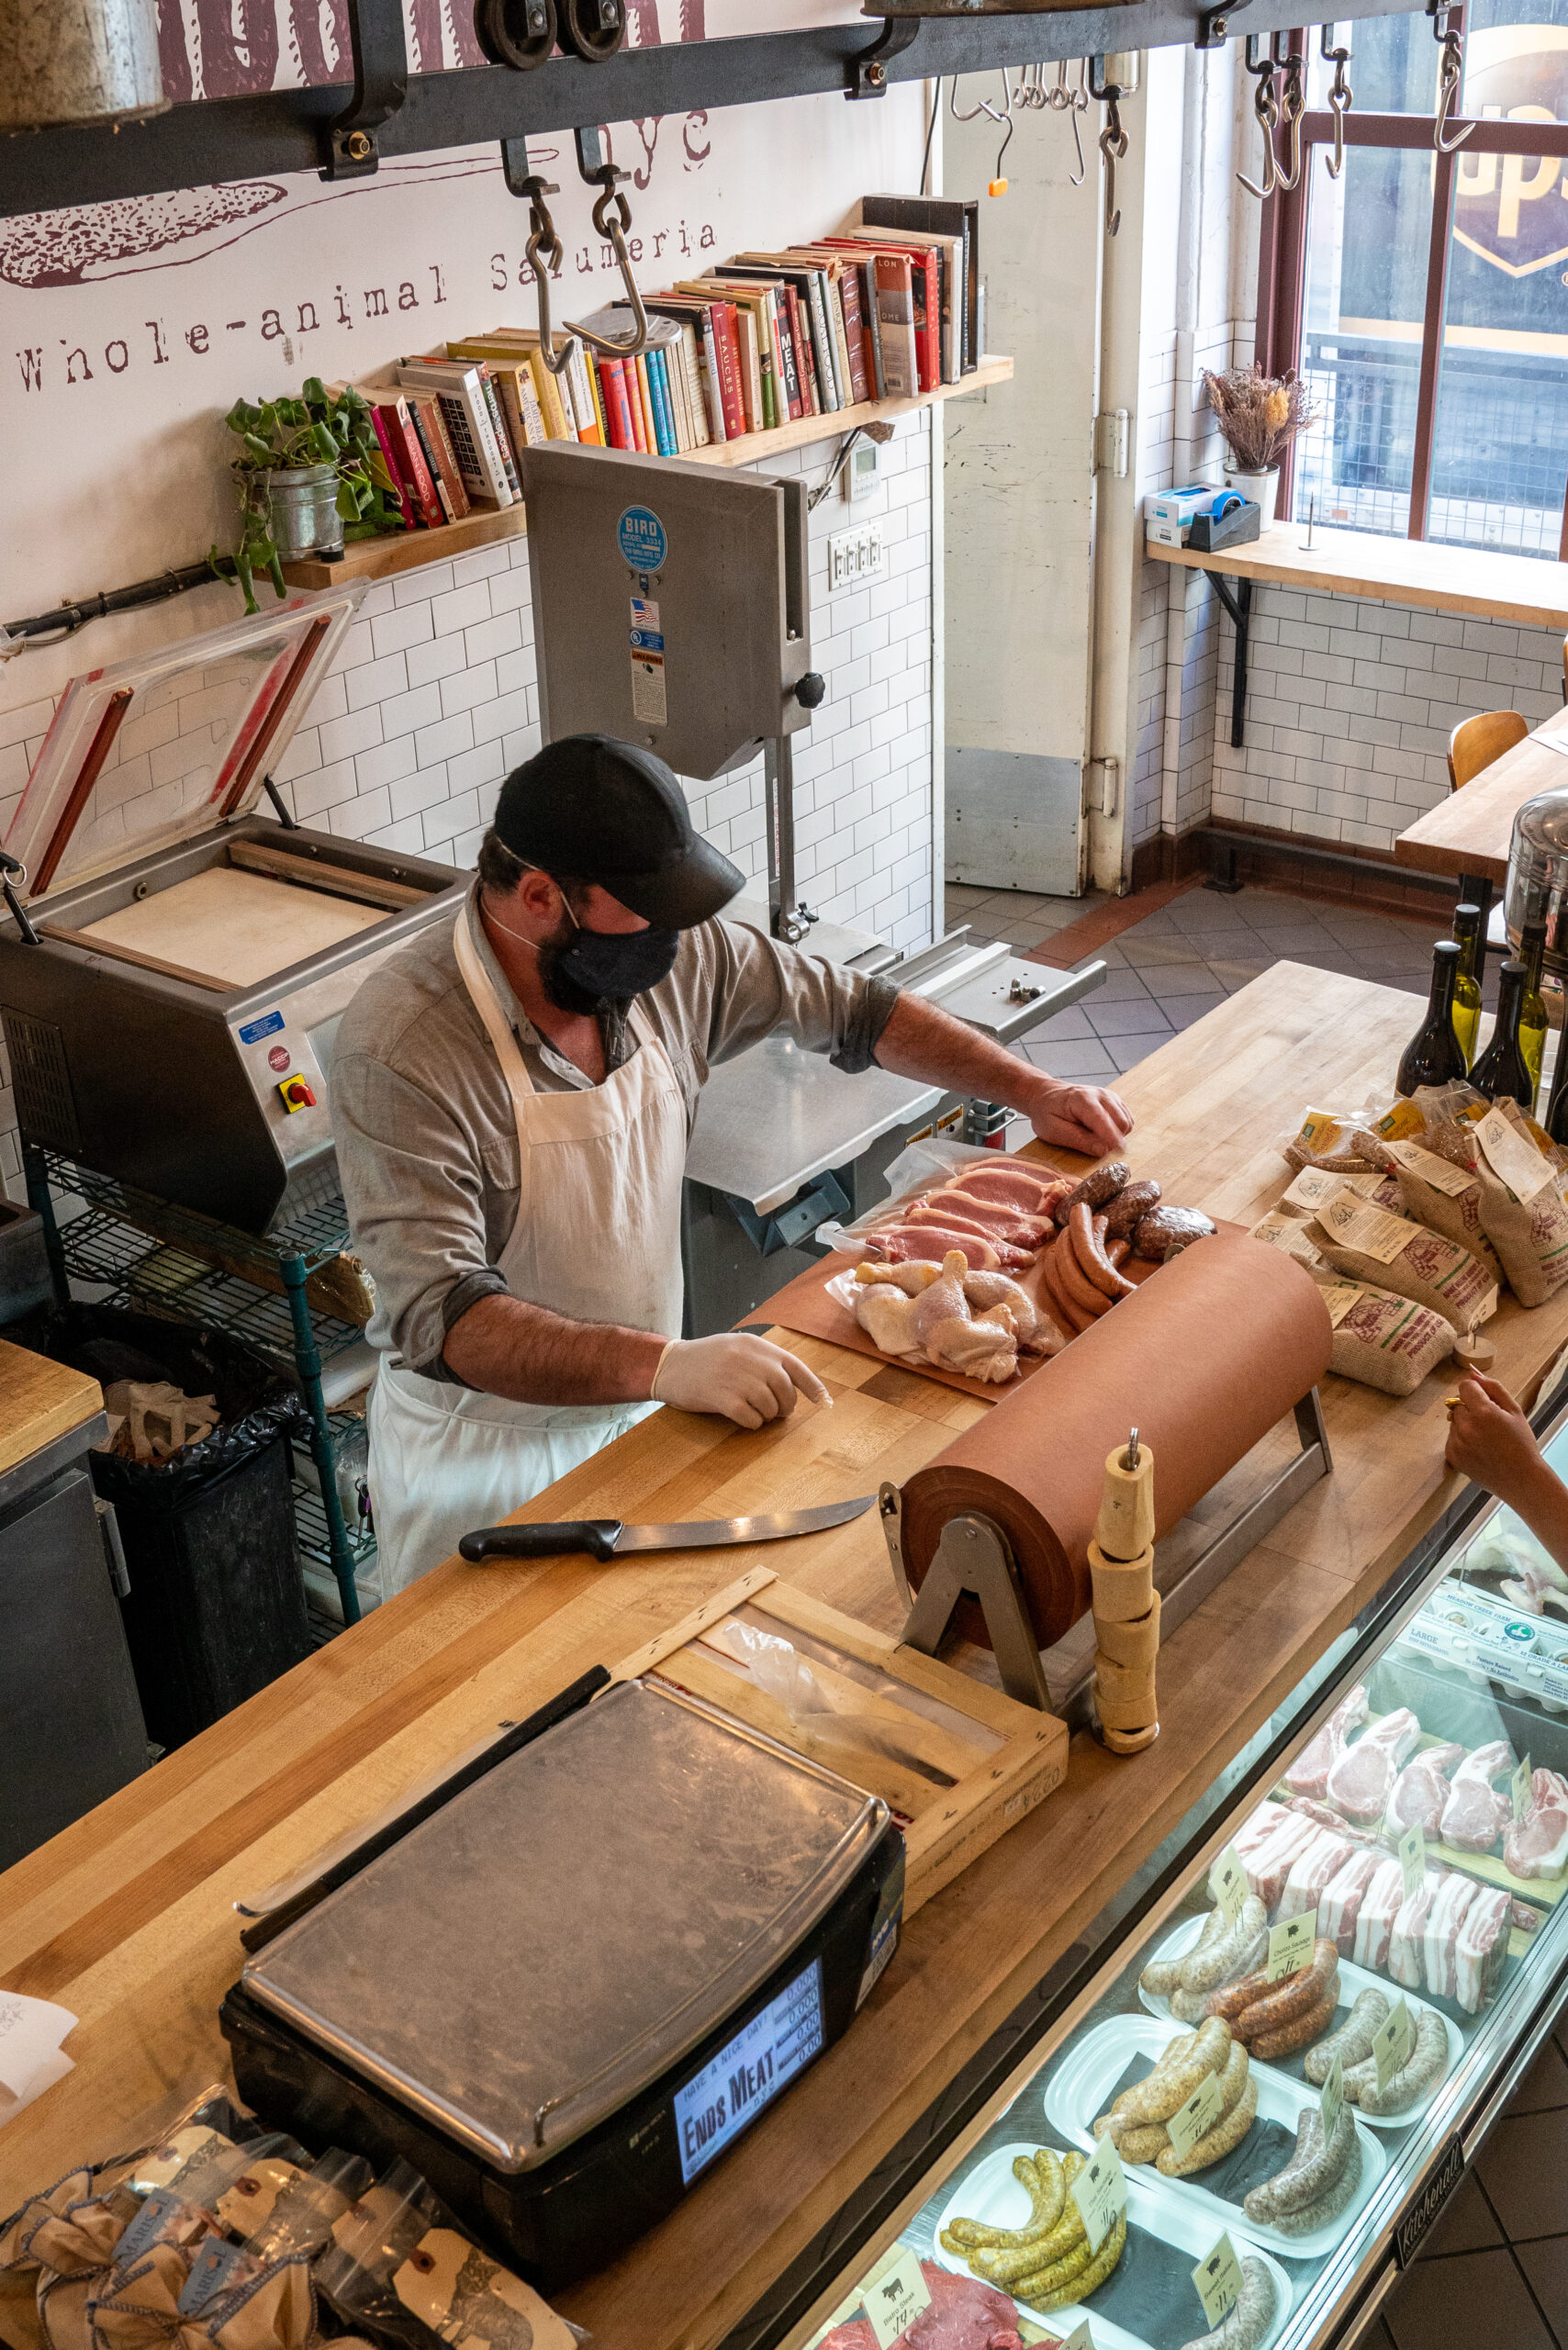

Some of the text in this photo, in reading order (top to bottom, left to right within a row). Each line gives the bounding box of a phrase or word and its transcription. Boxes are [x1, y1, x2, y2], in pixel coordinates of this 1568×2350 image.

[1456, 105, 1568, 238] up
[15, 218, 716, 394] Whole-animal Saumeria
[707, 340, 718, 376] Salted
[721, 334, 734, 394] SAUCES
[780, 331, 795, 392] MEAT
[823, 347, 835, 390] FOOD
[734, 365, 745, 417] FERMENTATION
[520, 386, 535, 434] AMERICAN
[529, 398, 540, 424] JAMES
[406, 435, 431, 503] ASIAN FOOD
[622, 532, 643, 543] MODEL
[636, 654, 663, 664] WARNING
[270, 1052, 290, 1065] HACCP
[1456, 1286, 1479, 1309] PRODUCT
[1406, 1331, 1432, 1359] PRODUCT
[1447, 1594, 1512, 1622] MEADOW CREEK FARM
[1410, 1628, 1439, 1645] LARGE
[1476, 1655, 1512, 1673] Pasture Raised
[1528, 1652, 1551, 1664] GRADE
[1273, 1946, 1292, 1957] Chorizo
[1291, 1936, 1311, 1950] Sausage
[787, 1964, 817, 2001] 0.000
[788, 1989, 818, 2024] 0.000
[797, 2010, 819, 2039] 0.00
[798, 2034, 822, 2062] 0.00
[683, 2076, 707, 2103] HAVE
[711, 2065, 718, 2076] A
[721, 2041, 744, 2064] NICE
[1096, 2169, 1113, 2194] Sausage
[883, 2291, 915, 2327] Bistro Steak
